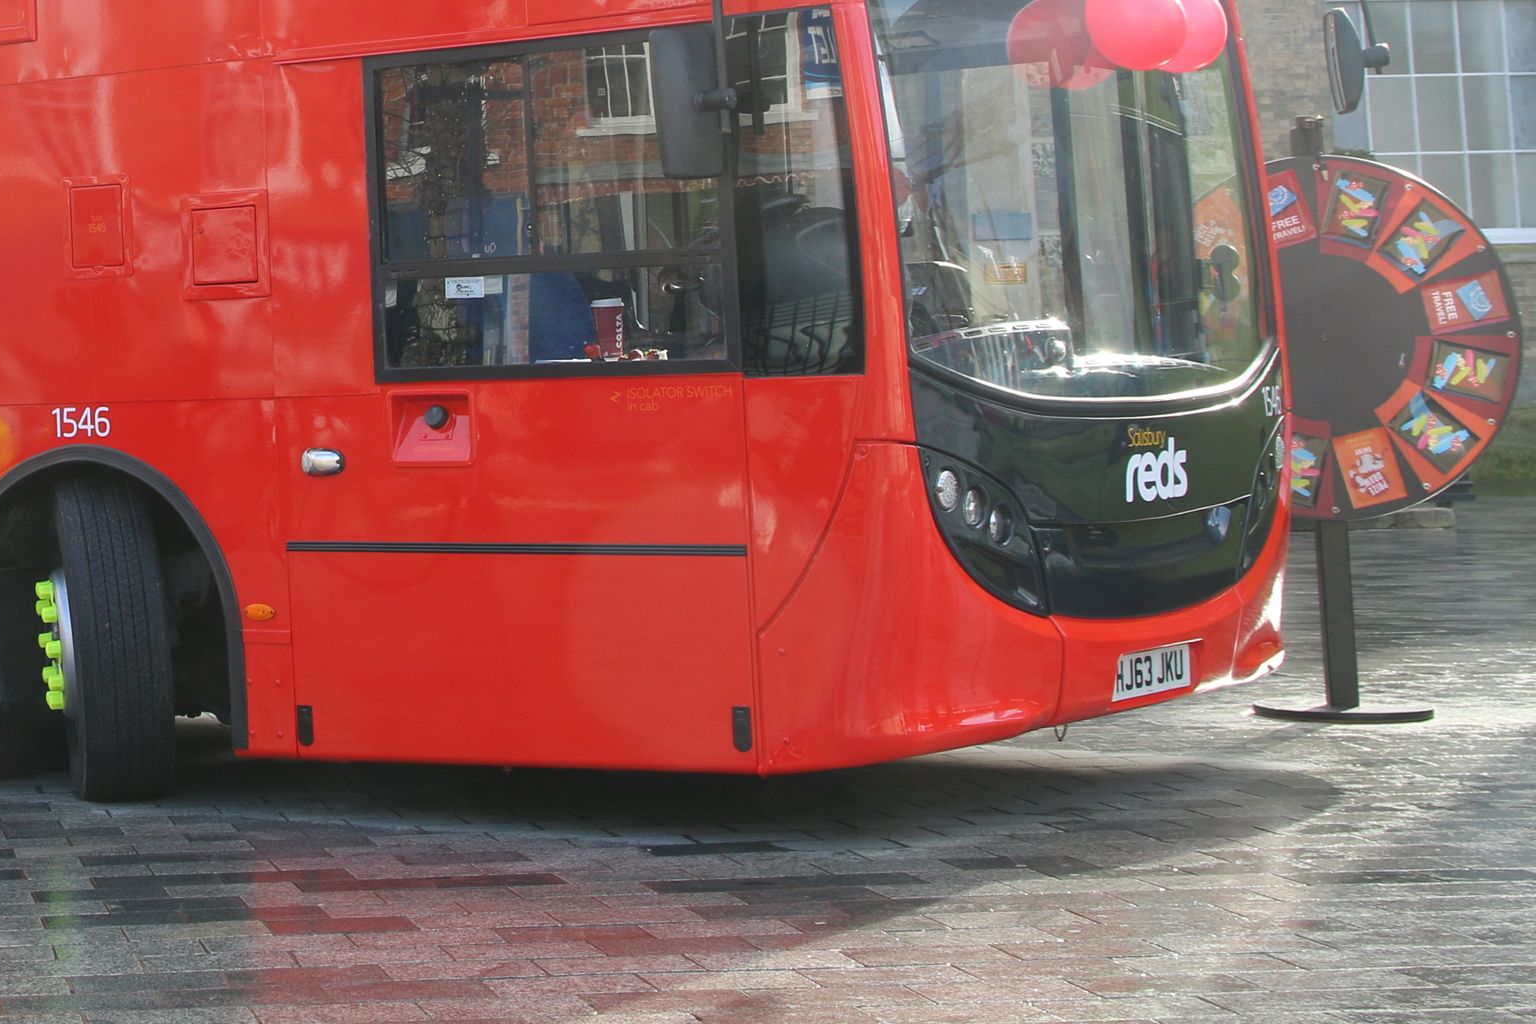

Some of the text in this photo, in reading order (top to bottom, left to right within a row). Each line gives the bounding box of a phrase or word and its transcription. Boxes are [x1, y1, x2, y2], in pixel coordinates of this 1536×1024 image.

[1272, 214, 1301, 232] FREE
[1441, 290, 1458, 322] FREE
[615, 312, 624, 349] COSTA
[627, 384, 733, 400] ISOLATOR SWITCH
[627, 400, 660, 412] in cab
[1261, 385, 1282, 416] 1546
[51, 406, 111, 438] 1546
[1127, 426, 1167, 449] Salisbury
[1124, 436, 1189, 503] reds
[1117, 649, 1183, 693] HJ63 JKU
